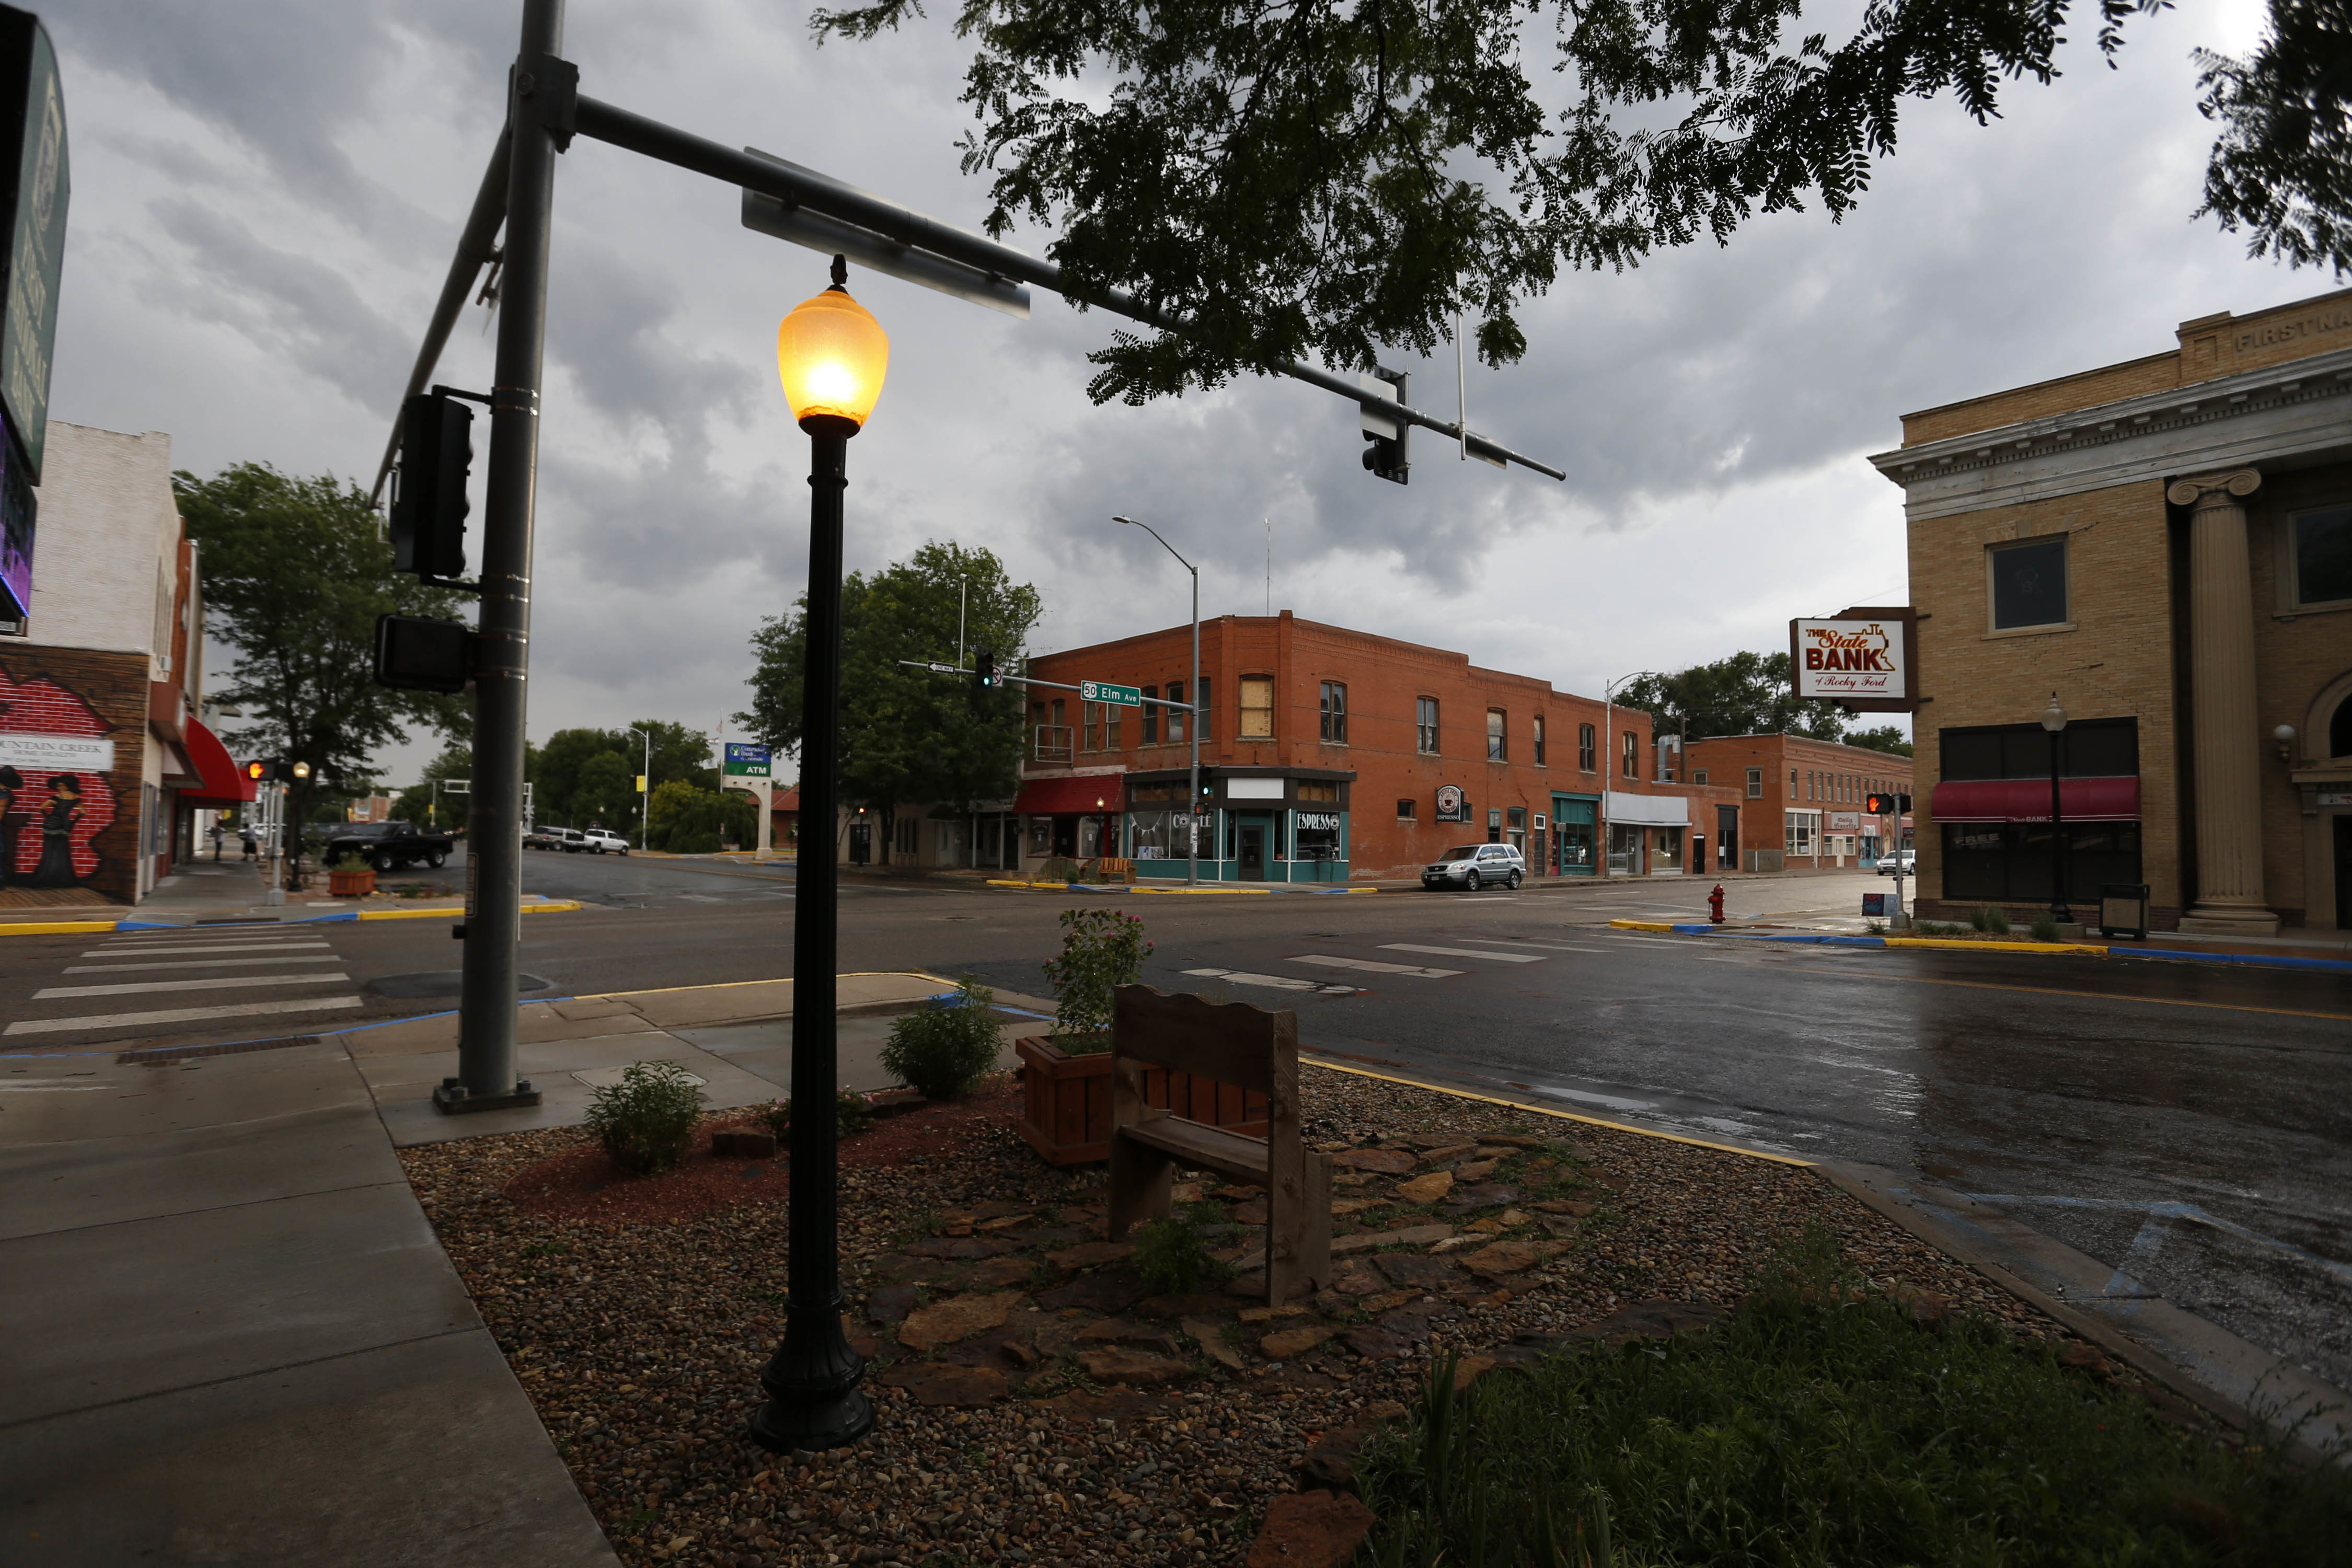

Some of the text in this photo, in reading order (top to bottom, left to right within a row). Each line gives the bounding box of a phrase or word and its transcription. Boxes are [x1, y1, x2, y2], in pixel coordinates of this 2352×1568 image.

[2235, 320, 2314, 352] FIRST
[1806, 629, 1868, 649] THE State
[1806, 648, 1883, 671] BANK
[1815, 676, 1887, 690] of Rocky Ford
[1085, 686, 1137, 702] 50 Elm Ave
[0, 740, 102, 753] UNTAIN CREEK
